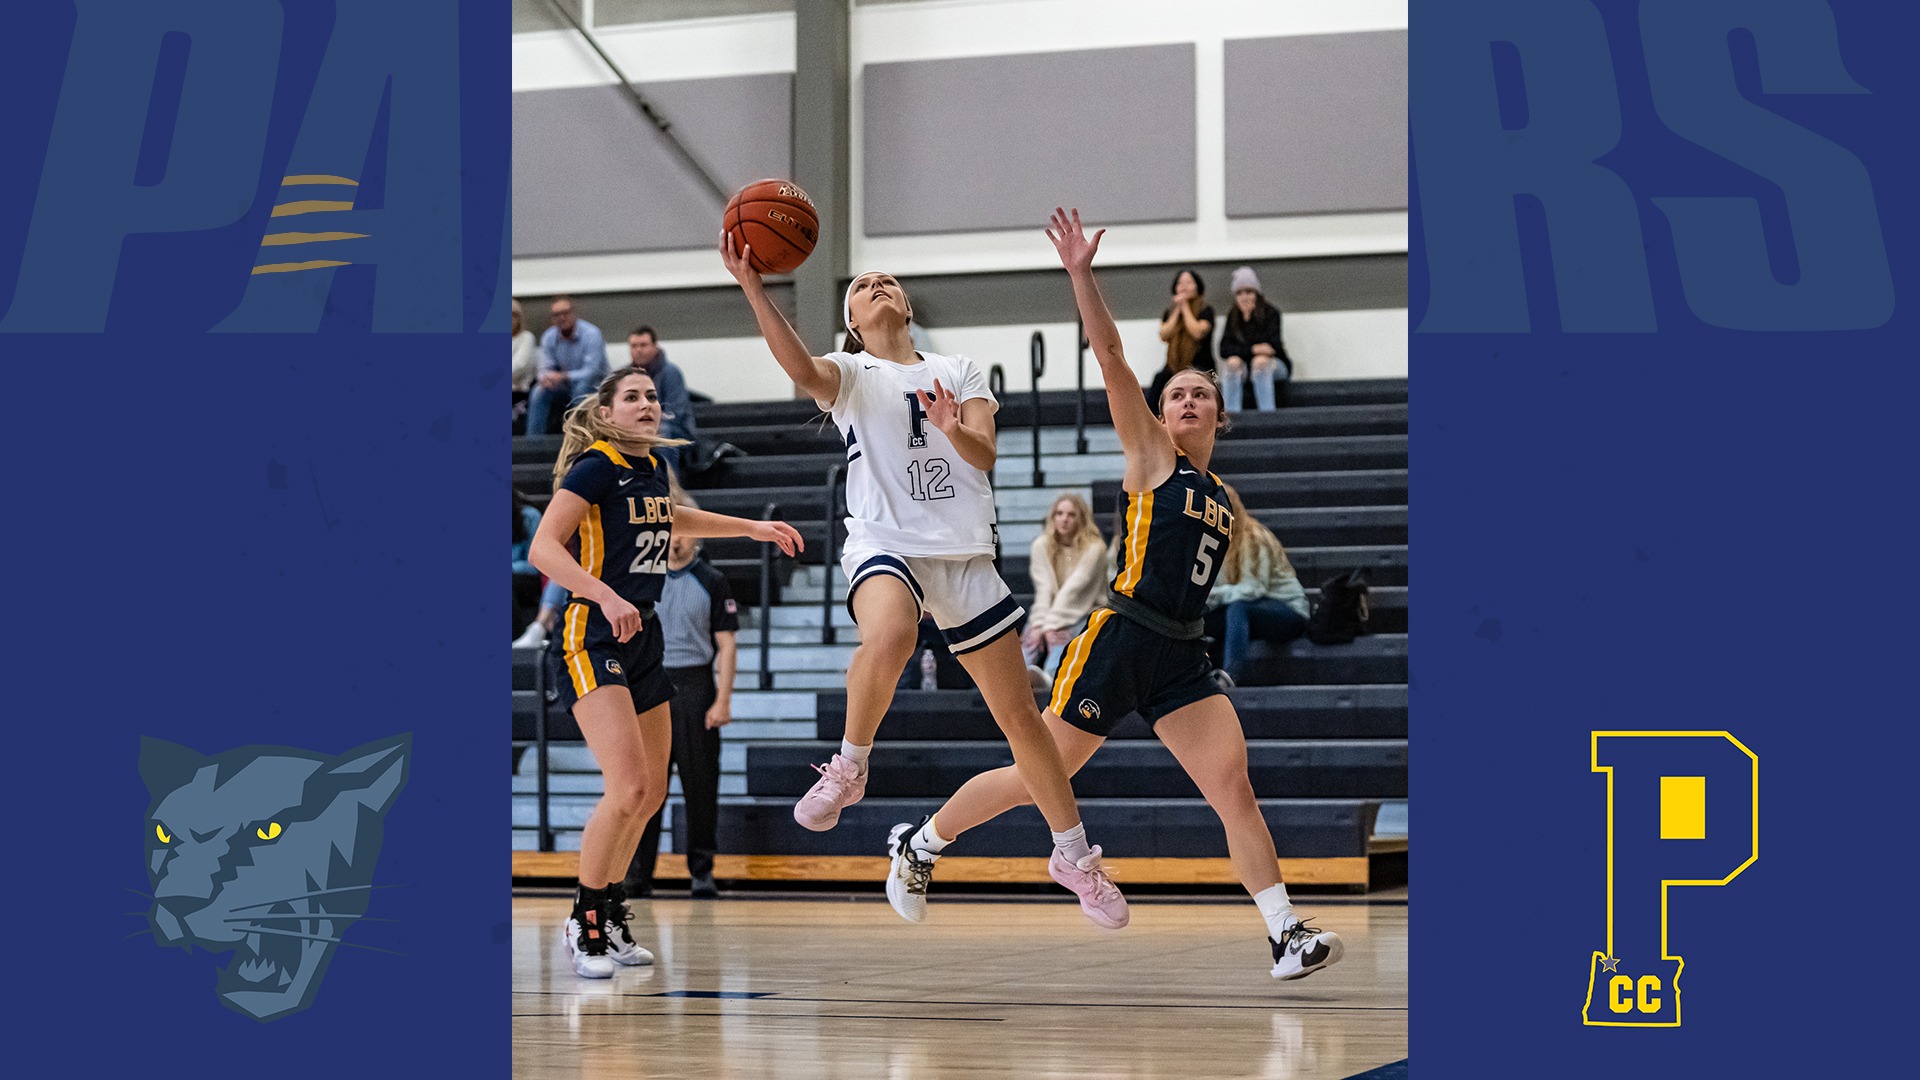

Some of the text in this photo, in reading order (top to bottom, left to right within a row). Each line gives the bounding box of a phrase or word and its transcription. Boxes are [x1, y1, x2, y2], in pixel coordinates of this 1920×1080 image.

[912, 438, 924, 446] CC
[907, 458, 955, 501] 12
[628, 530, 668, 574] 22
[1190, 532, 1220, 587] 5
